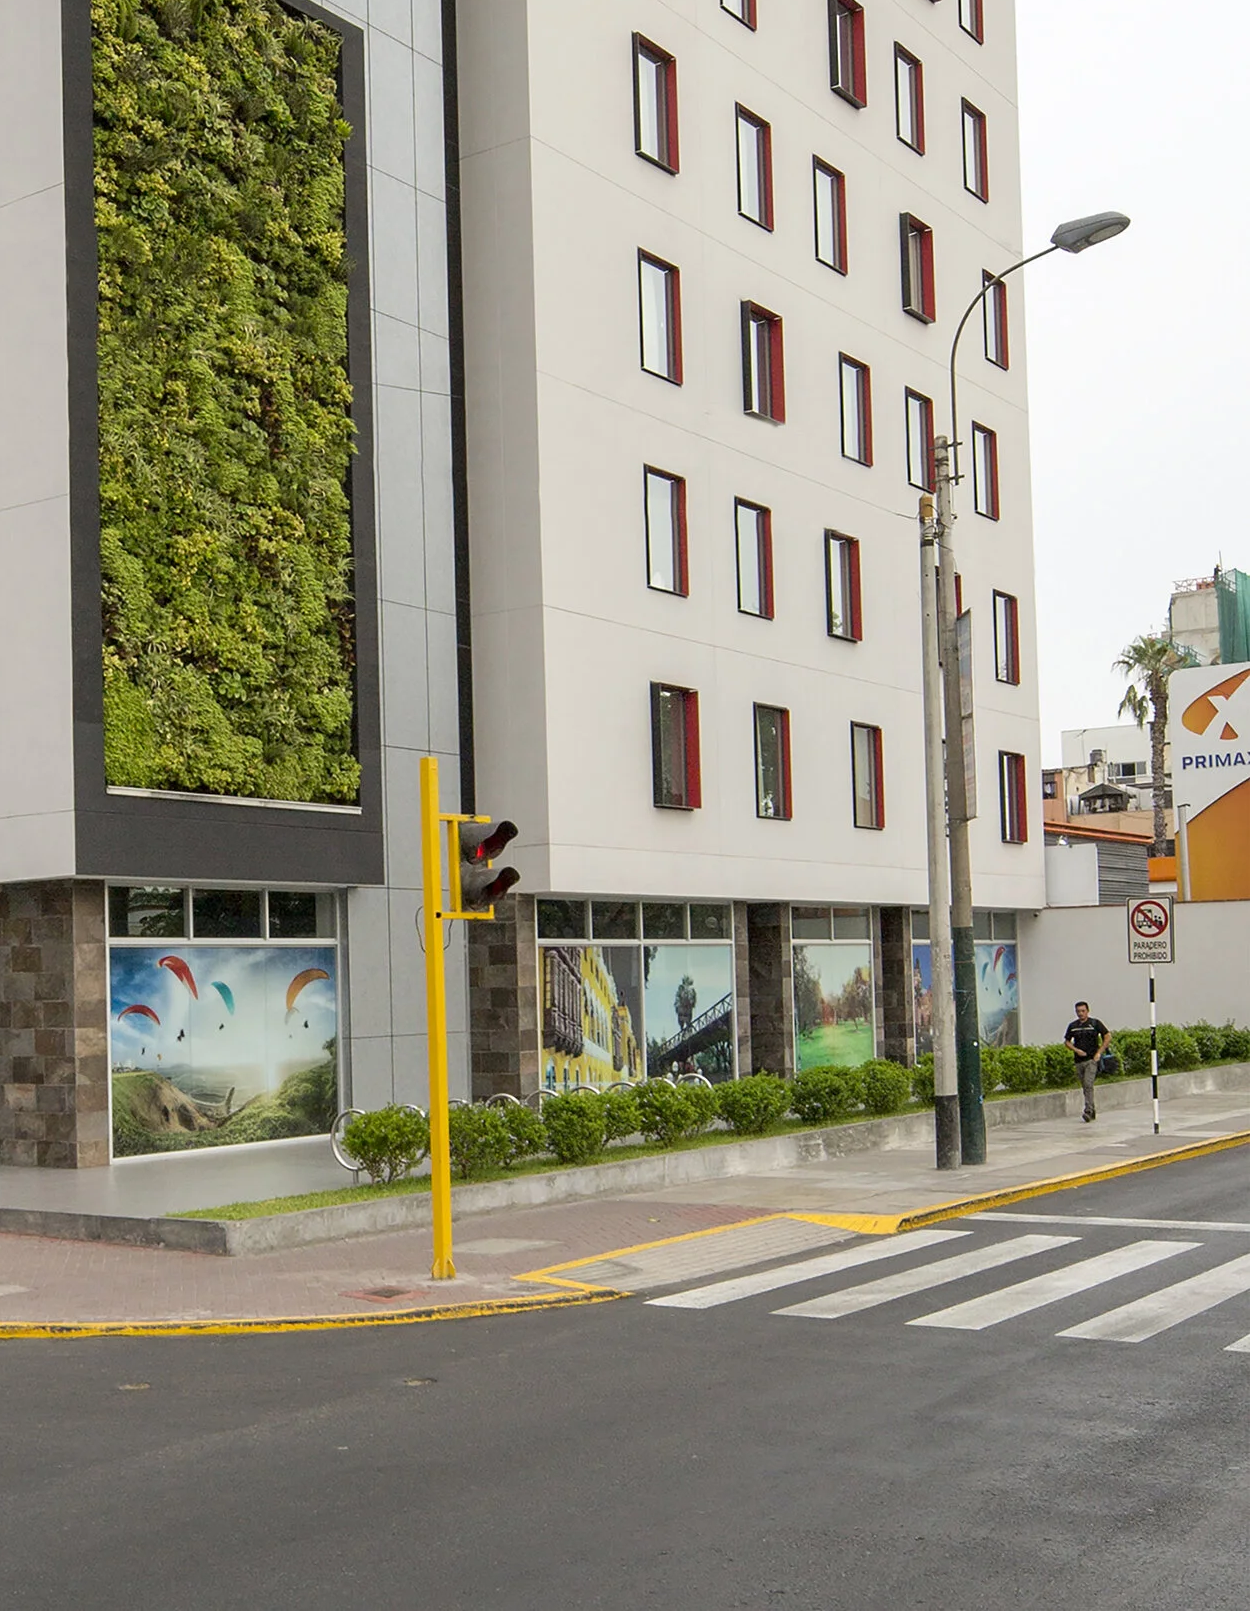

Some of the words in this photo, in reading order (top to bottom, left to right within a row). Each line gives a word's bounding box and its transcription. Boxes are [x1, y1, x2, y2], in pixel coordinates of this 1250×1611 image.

[1181, 750, 1250, 771] PRIMA
[1133, 941, 1168, 950] PARADERO
[1133, 951, 1168, 960] PROHIBIDO
